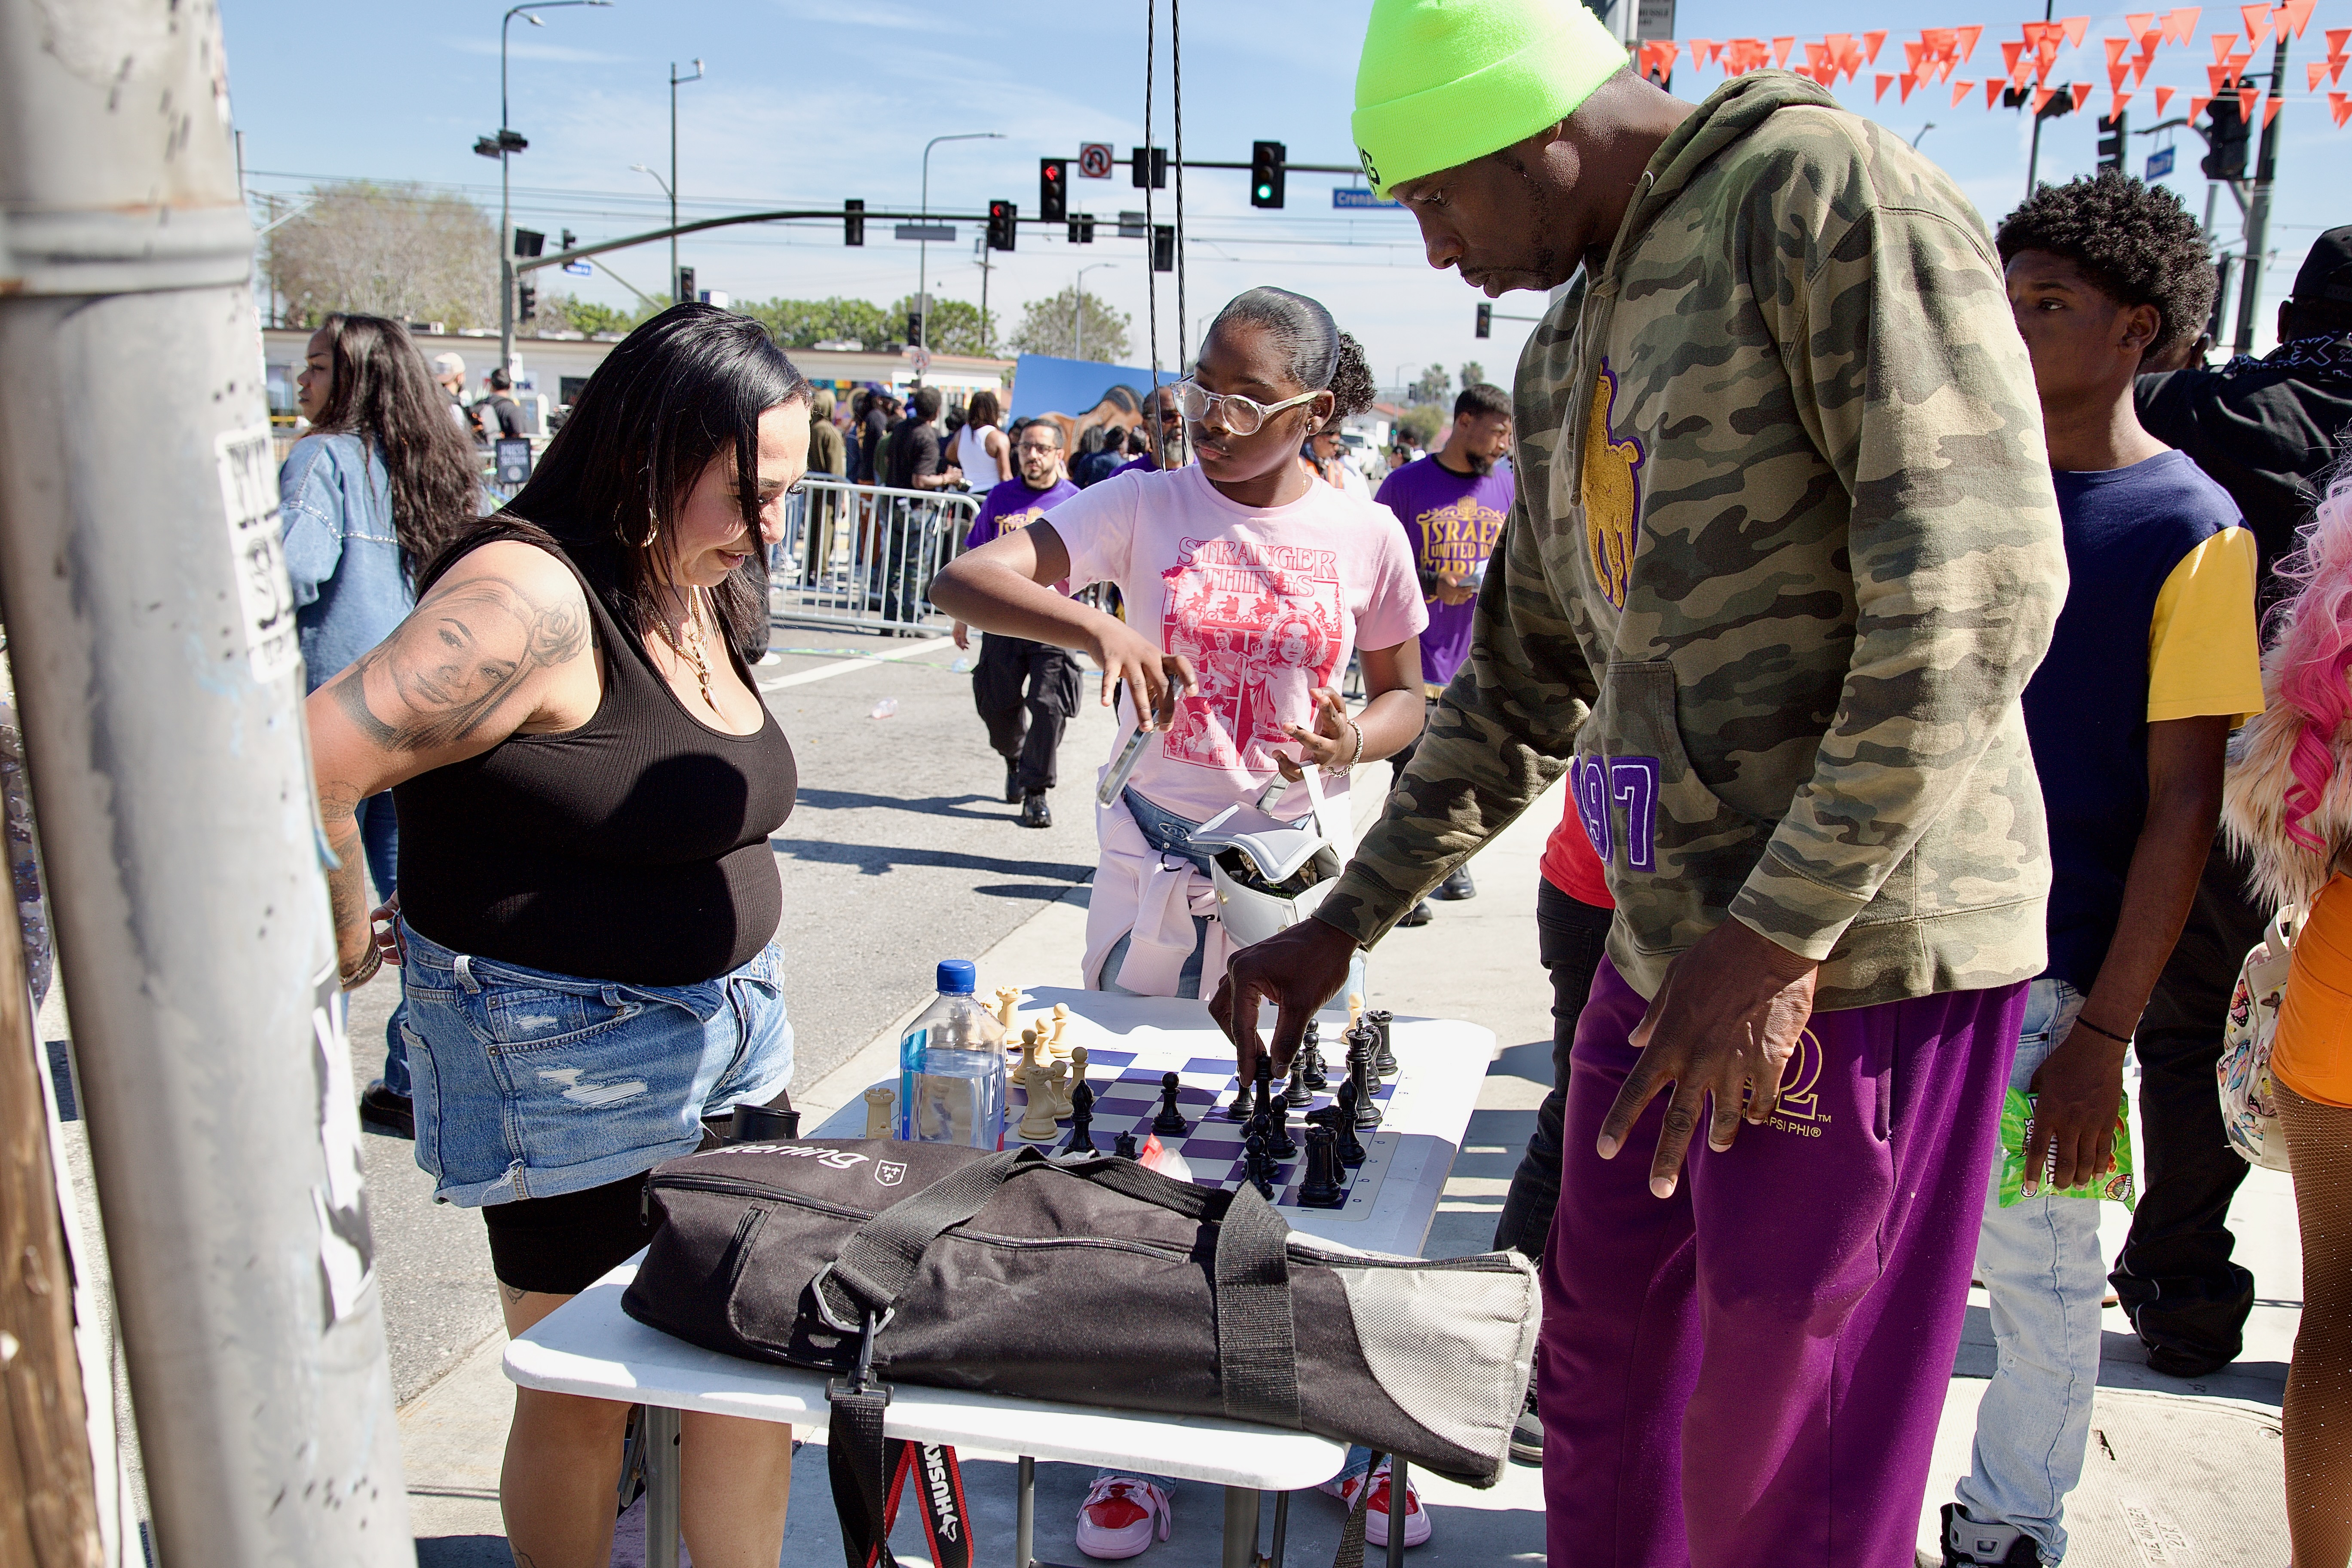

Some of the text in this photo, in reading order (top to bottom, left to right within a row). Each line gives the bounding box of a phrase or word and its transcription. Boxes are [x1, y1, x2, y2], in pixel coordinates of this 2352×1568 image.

[1177, 537, 1339, 579] STRANGER
[1431, 543, 1476, 559] UNITED
[1202, 567, 1314, 597] THINGS
[988, 1071, 1004, 1115] FIJ
[923, 1442, 953, 1516] HUSKY
